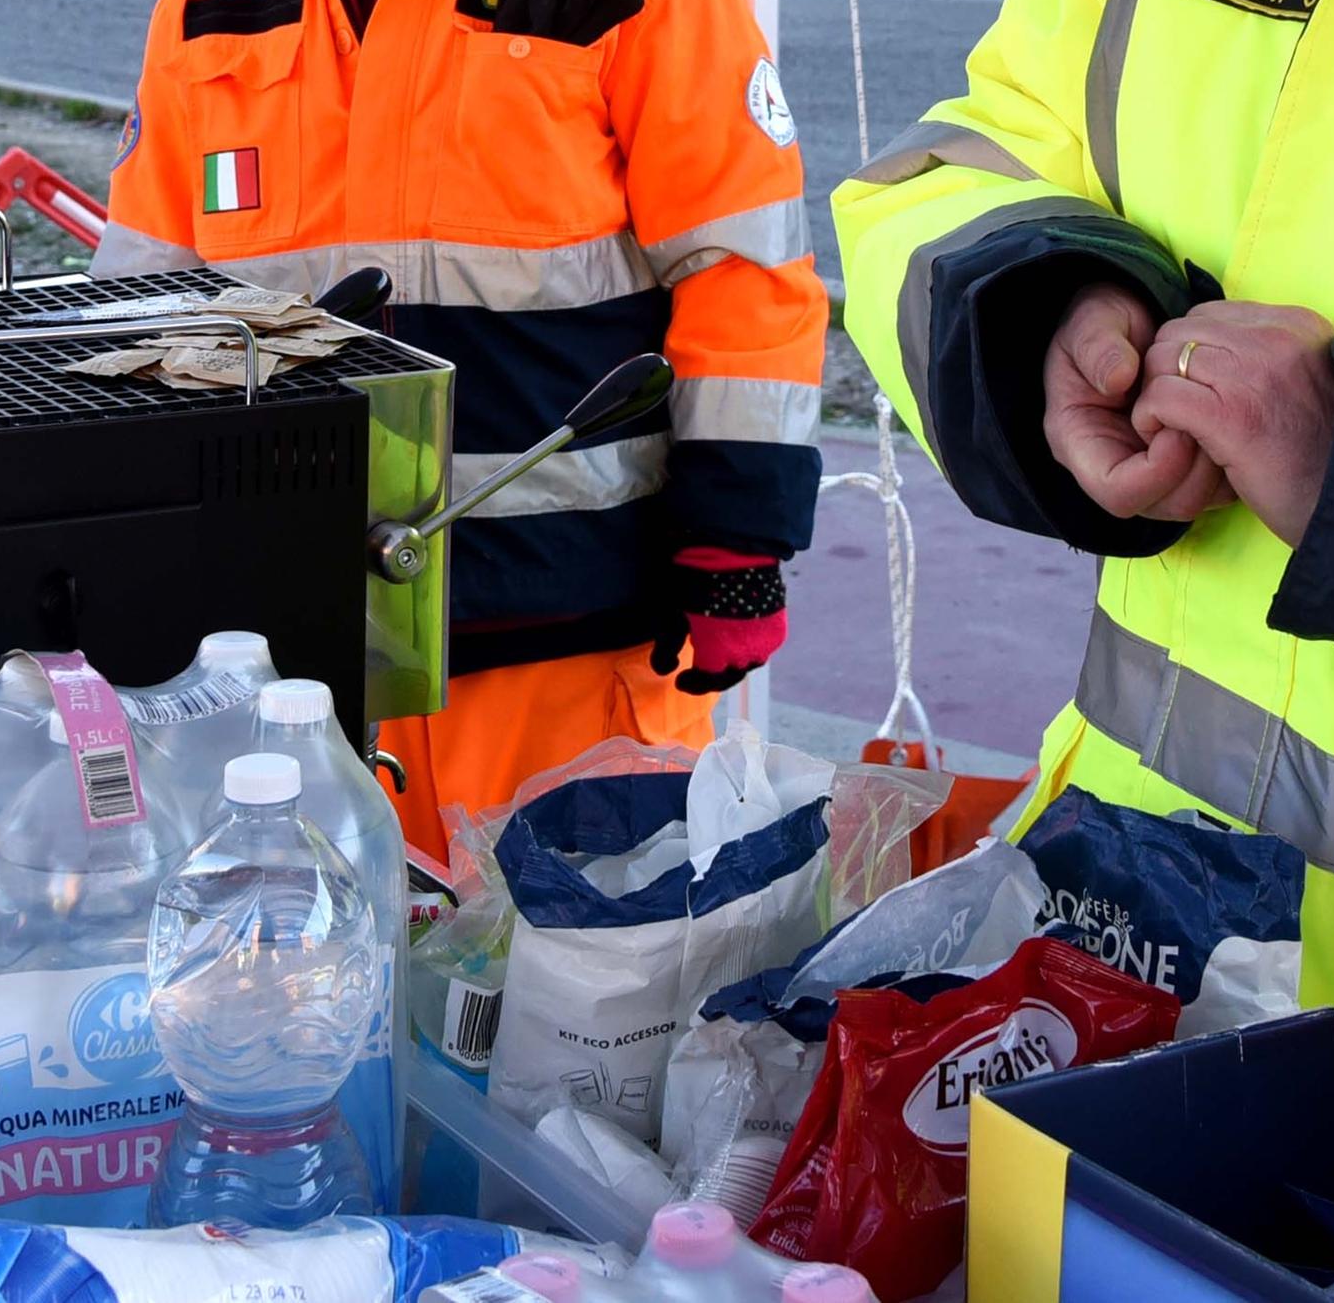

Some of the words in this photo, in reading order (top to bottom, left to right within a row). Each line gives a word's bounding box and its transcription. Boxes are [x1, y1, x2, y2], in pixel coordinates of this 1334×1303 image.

[558, 1029, 578, 1042] KIT
[583, 1037, 609, 1049] ECO
[52, 1095, 161, 1128] MINERALE
